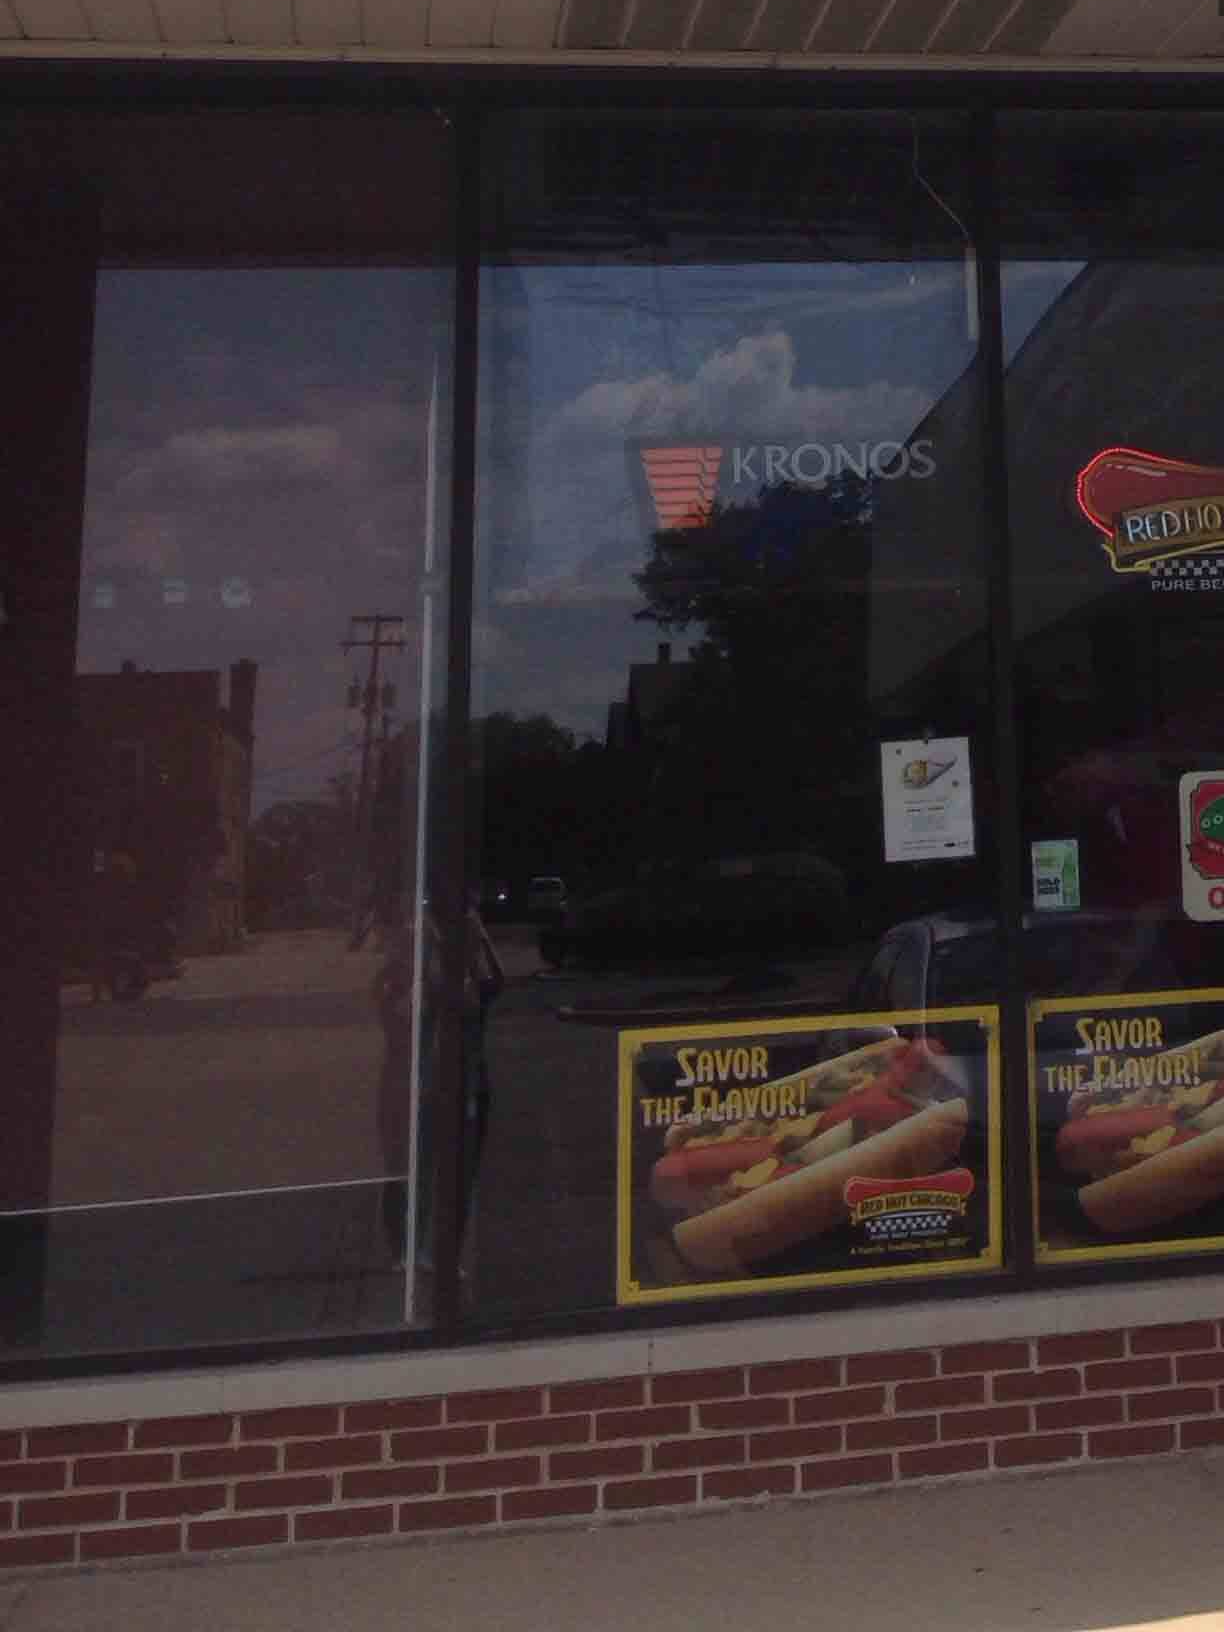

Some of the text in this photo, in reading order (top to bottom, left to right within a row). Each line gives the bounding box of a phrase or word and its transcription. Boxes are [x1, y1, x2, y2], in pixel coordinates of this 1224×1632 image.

[732, 438, 938, 485] KRONOS
[1126, 509, 1182, 543] RED
[1151, 578, 1197, 592] PURE
[1044, 1064, 1088, 1094] THE
[640, 1097, 689, 1128] THE
